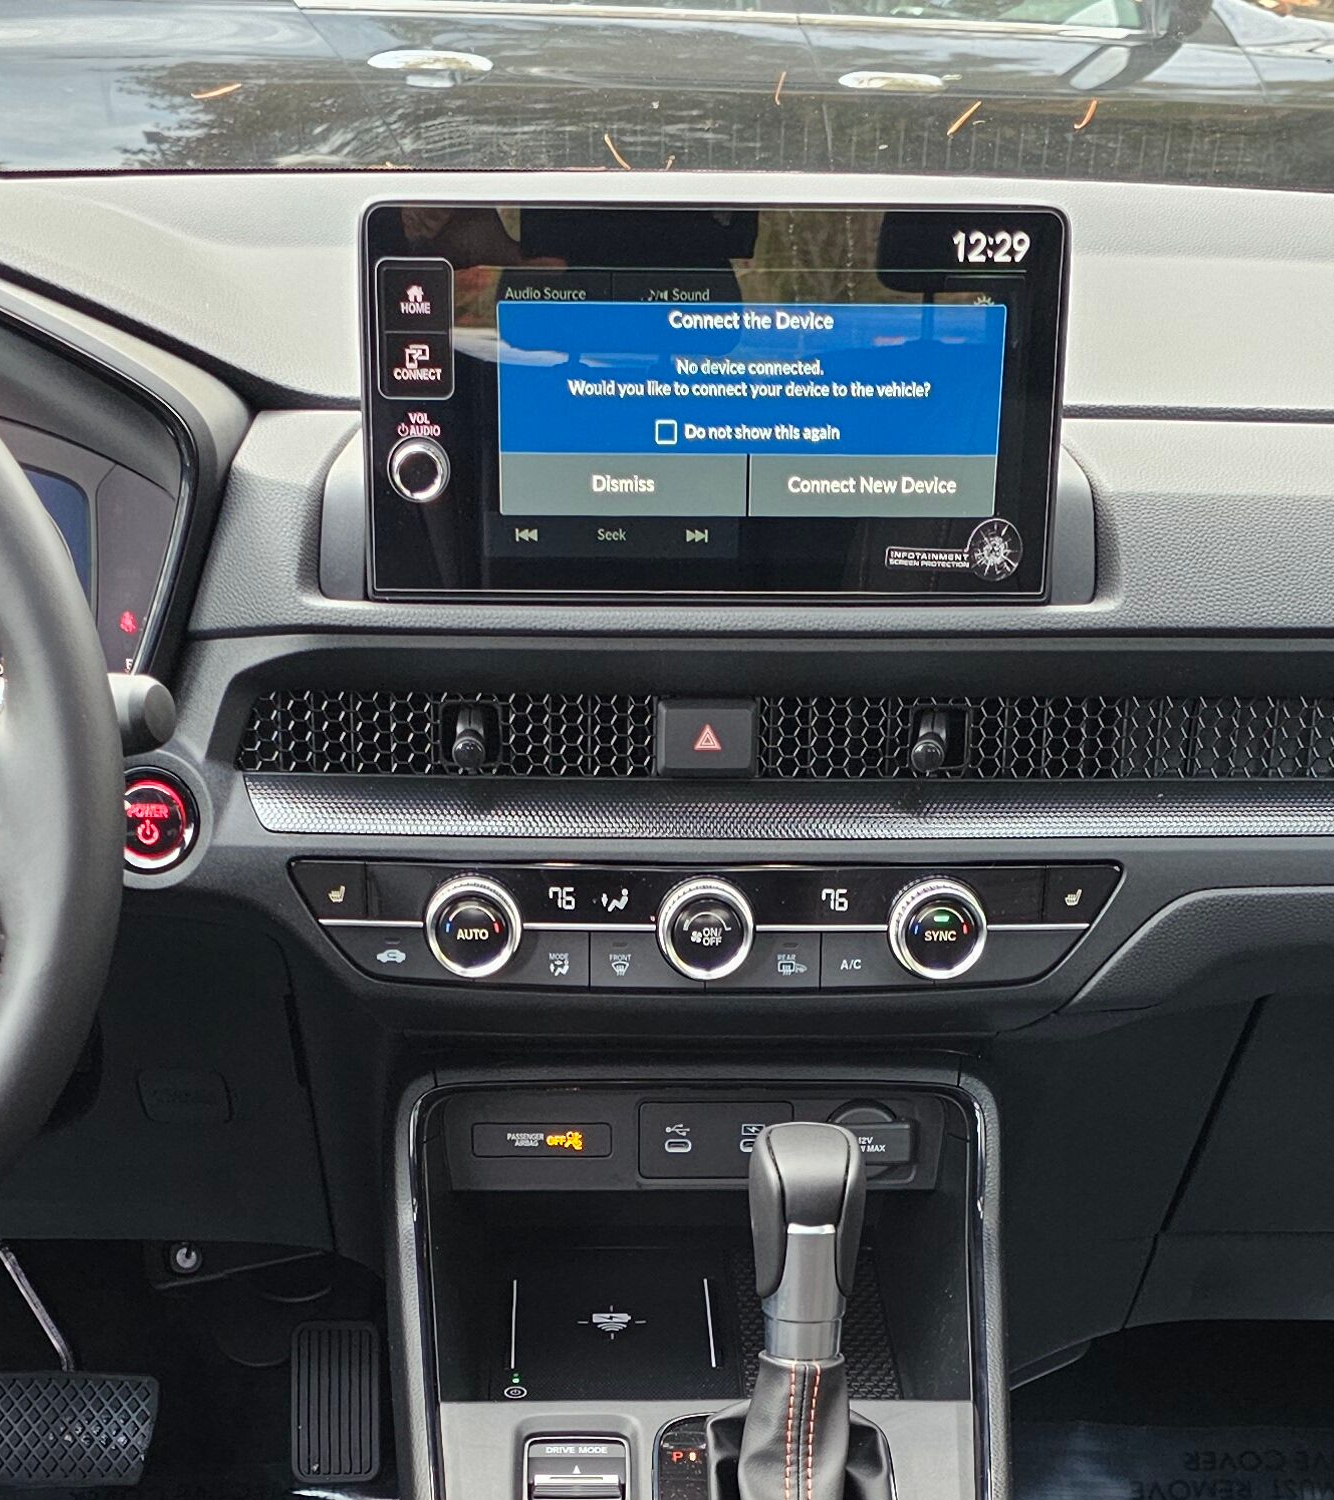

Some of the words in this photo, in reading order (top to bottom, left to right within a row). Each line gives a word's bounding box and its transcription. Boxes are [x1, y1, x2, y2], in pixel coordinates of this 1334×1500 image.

[952, 230, 1031, 263] 12:29
[504, 287, 541, 301] Audio
[543, 287, 587, 301] Source
[671, 288, 710, 302] Sound
[400, 302, 431, 315] HOME
[668, 310, 741, 330] Connect
[743, 311, 772, 330] the
[775, 311, 835, 330] Device
[393, 367, 443, 381] CONNECT
[675, 359, 699, 376] No
[701, 359, 746, 376] device
[748, 359, 825, 376] connected.
[567, 379, 616, 397] Would
[617, 382, 644, 399] you
[647, 380, 671, 397] like
[673, 380, 689, 397] to
[691, 380, 748, 397] connect
[750, 383, 782, 399] your
[785, 381, 830, 398] device
[832, 382, 848, 398] to
[850, 381, 874, 398] the
[876, 381, 931, 399] vehicle?
[407, 412, 431, 424] VOL
[409, 425, 442, 437] AUDIO
[683, 423, 706, 440] Do
[708, 423, 733, 440] not
[734, 423, 773, 440] show
[774, 424, 801, 440] this
[803, 424, 841, 442] again
[591, 474, 656, 493] Dismiss
[787, 476, 856, 495] Connect
[860, 476, 898, 495] New
[901, 476, 958, 495] Device
[597, 528, 627, 542] Seek
[890, 550, 969, 561] INFOTAINMENT
[127, 803, 169, 818] POWER
[548, 886, 576, 910] 76
[821, 888, 849, 912] 76
[456, 928, 489, 941] AUTO
[702, 935, 722, 946] OFF
[924, 930, 957, 942] SYNC
[548, 953, 569, 961] MODE
[609, 953, 632, 962] FRONT
[840, 959, 862, 970] A/C
[506, 1132, 545, 1141] PASSENGER
[514, 1139, 539, 1147] AIRBAG
[546, 1135, 566, 1146] OFF
[867, 1144, 886, 1153] MAX
[545, 1446, 576, 1454] DRIVE
[578, 1446, 608, 1454] MODE
